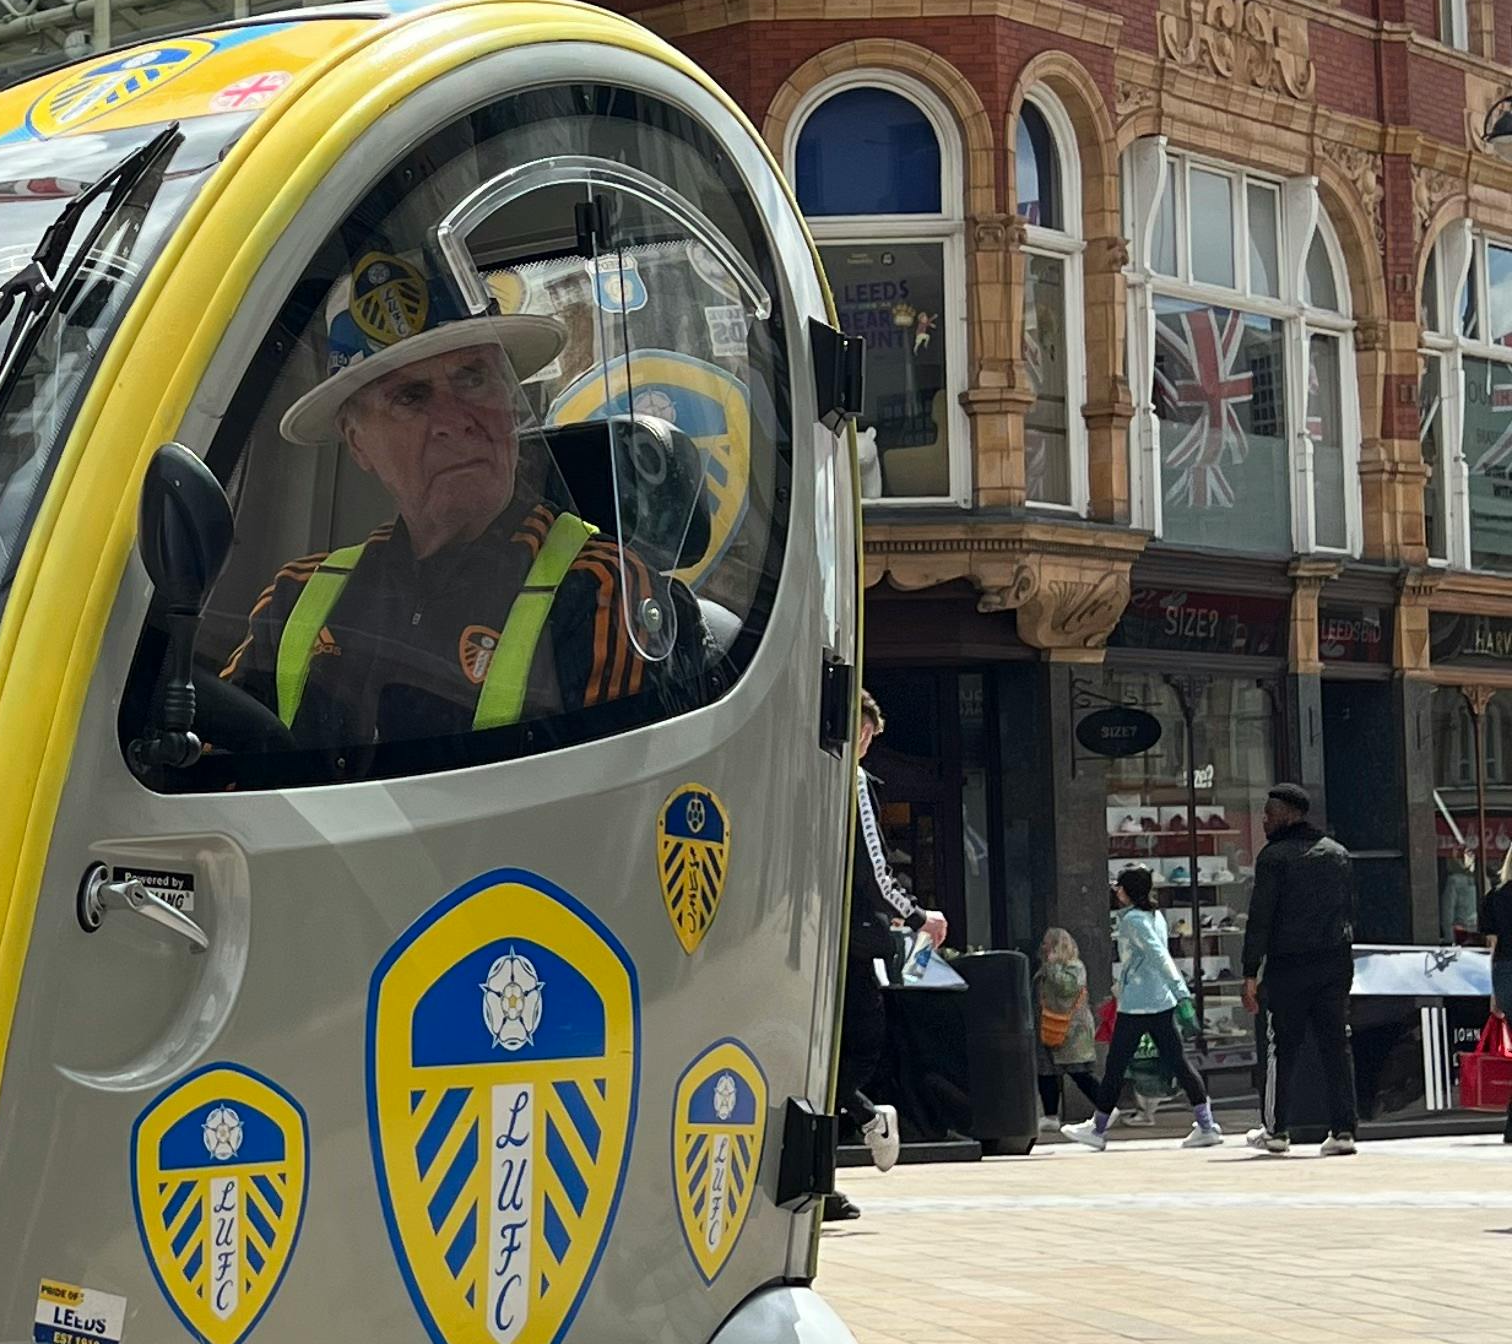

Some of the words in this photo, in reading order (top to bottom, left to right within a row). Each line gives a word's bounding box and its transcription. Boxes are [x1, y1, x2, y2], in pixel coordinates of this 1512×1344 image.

[844, 280, 909, 304] LEEDS
[1163, 604, 1219, 638] SIZE?
[1100, 725, 1138, 739] SIZE?
[172, 876, 185, 889] by
[707, 1138, 727, 1247] LUFC
[494, 1090, 530, 1331] LUFC
[214, 1181, 237, 1312] LUFC
[53, 1306, 106, 1334] LEEDS
[53, 1331, 73, 1344] EST
